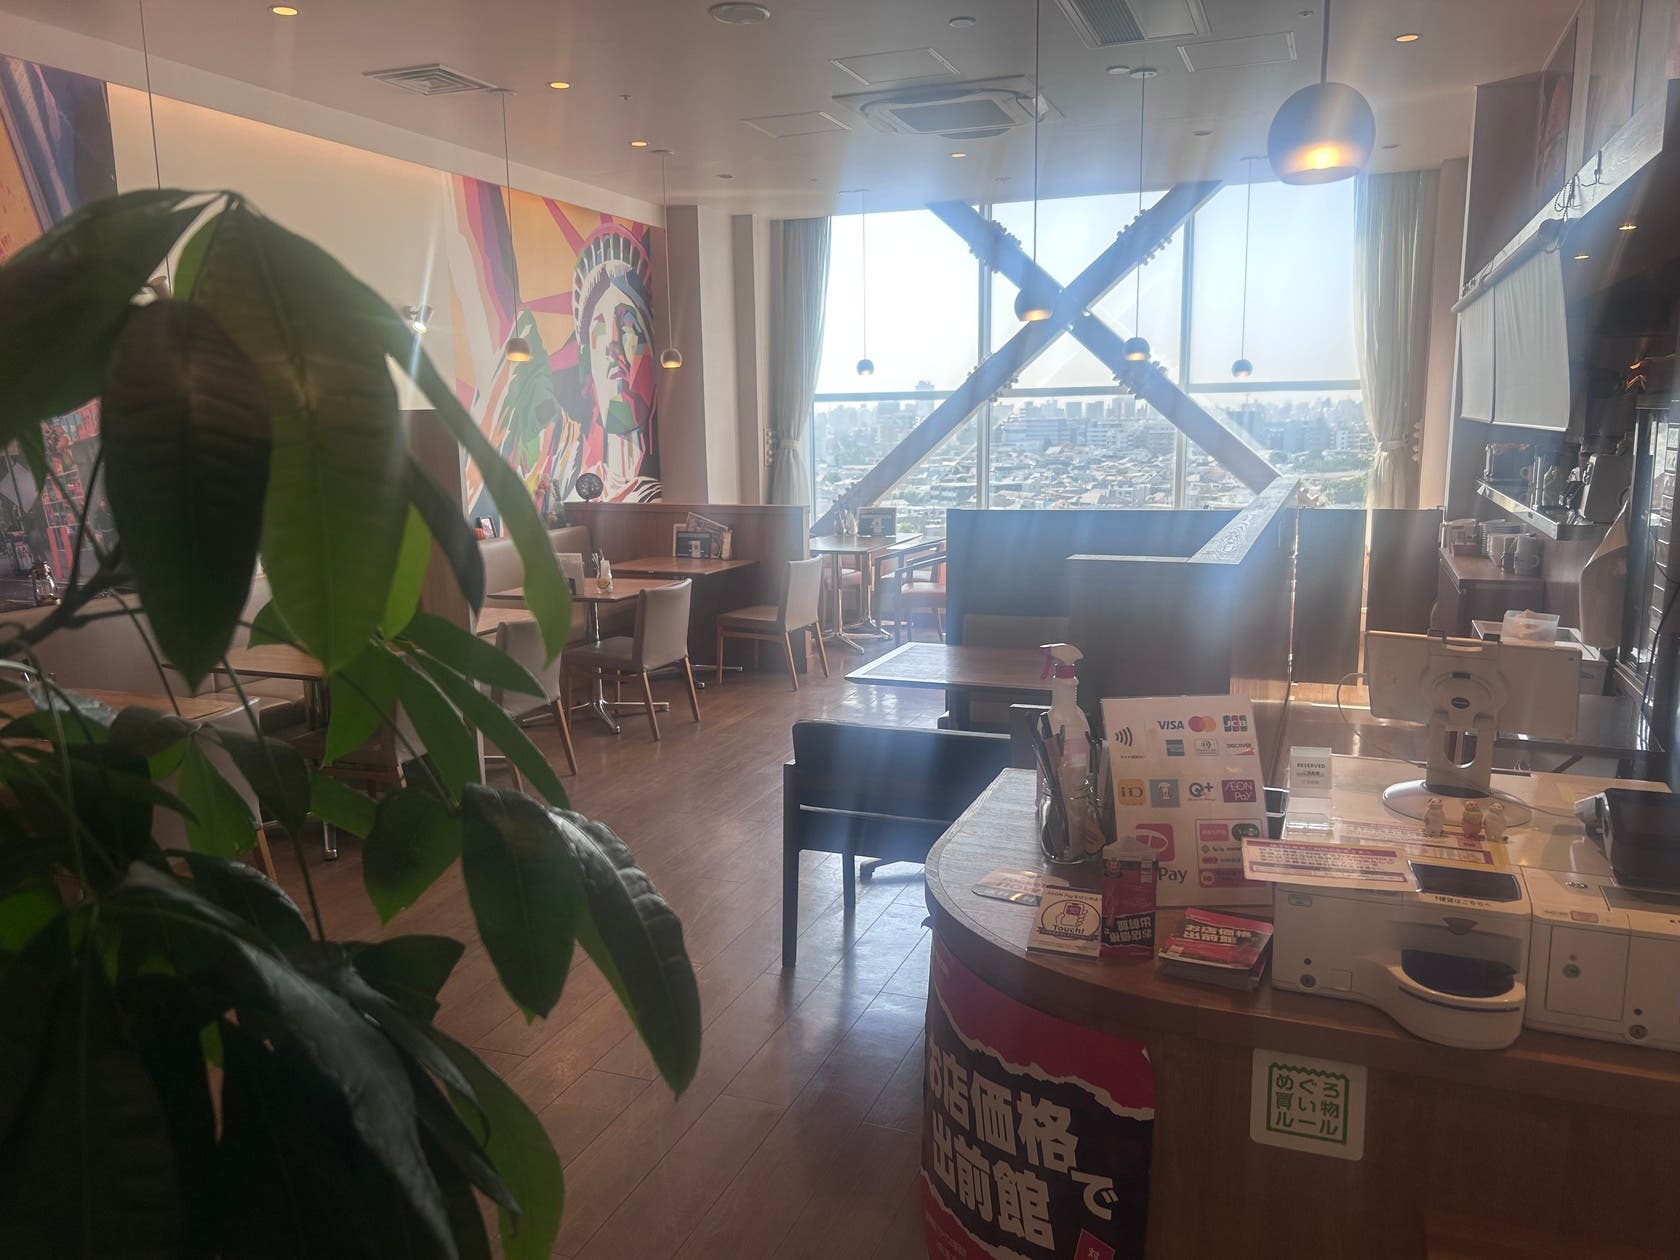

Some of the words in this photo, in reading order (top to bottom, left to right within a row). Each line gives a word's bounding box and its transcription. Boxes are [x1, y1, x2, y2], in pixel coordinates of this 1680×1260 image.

[1157, 720, 1185, 730] VISA
[1052, 924, 1085, 935] Touch!
[1275, 1074, 1340, 1099] めぐろ
[1275, 1091, 1340, 1118] 買い物
[1275, 1111, 1339, 1135] ルール
[932, 1110, 1056, 1250] 出前館
